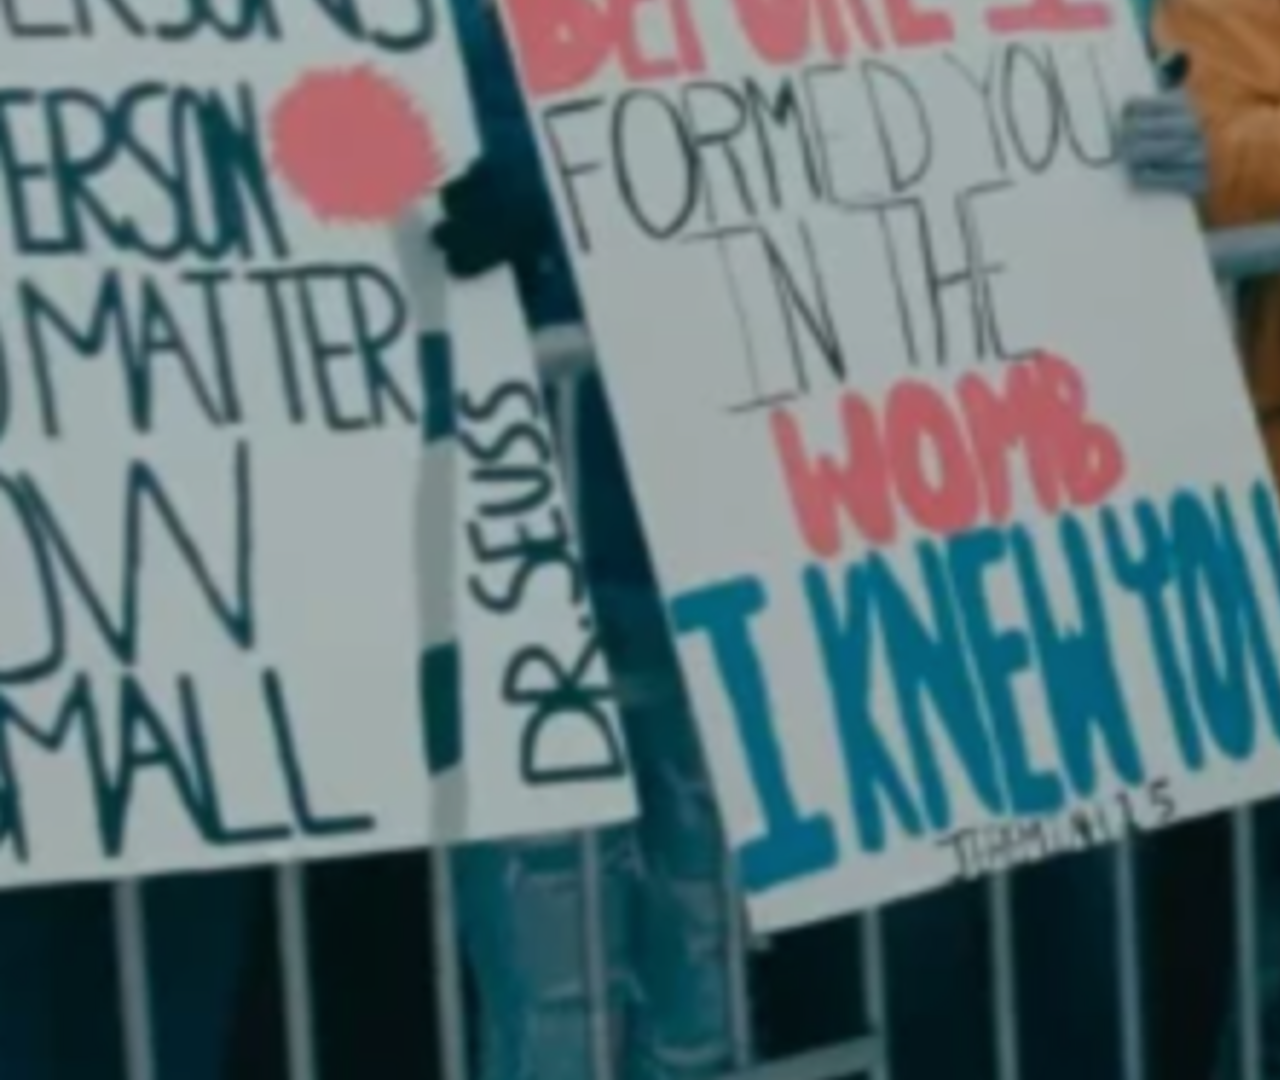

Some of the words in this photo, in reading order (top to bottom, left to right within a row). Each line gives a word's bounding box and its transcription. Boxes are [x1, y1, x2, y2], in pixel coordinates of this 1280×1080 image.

[542, 58, 933, 254] FORMED
[941, 41, 1121, 174] YOU
[16, 263, 420, 437] MATTER
[678, 218, 847, 415] IN
[852, 178, 1047, 368] THE
[454, 379, 587, 615] SEUSS
[769, 352, 1126, 560] WOMB
[0, 666, 377, 863] MALL
[669, 573, 839, 895] I
[801, 508, 1147, 854] KNEW
